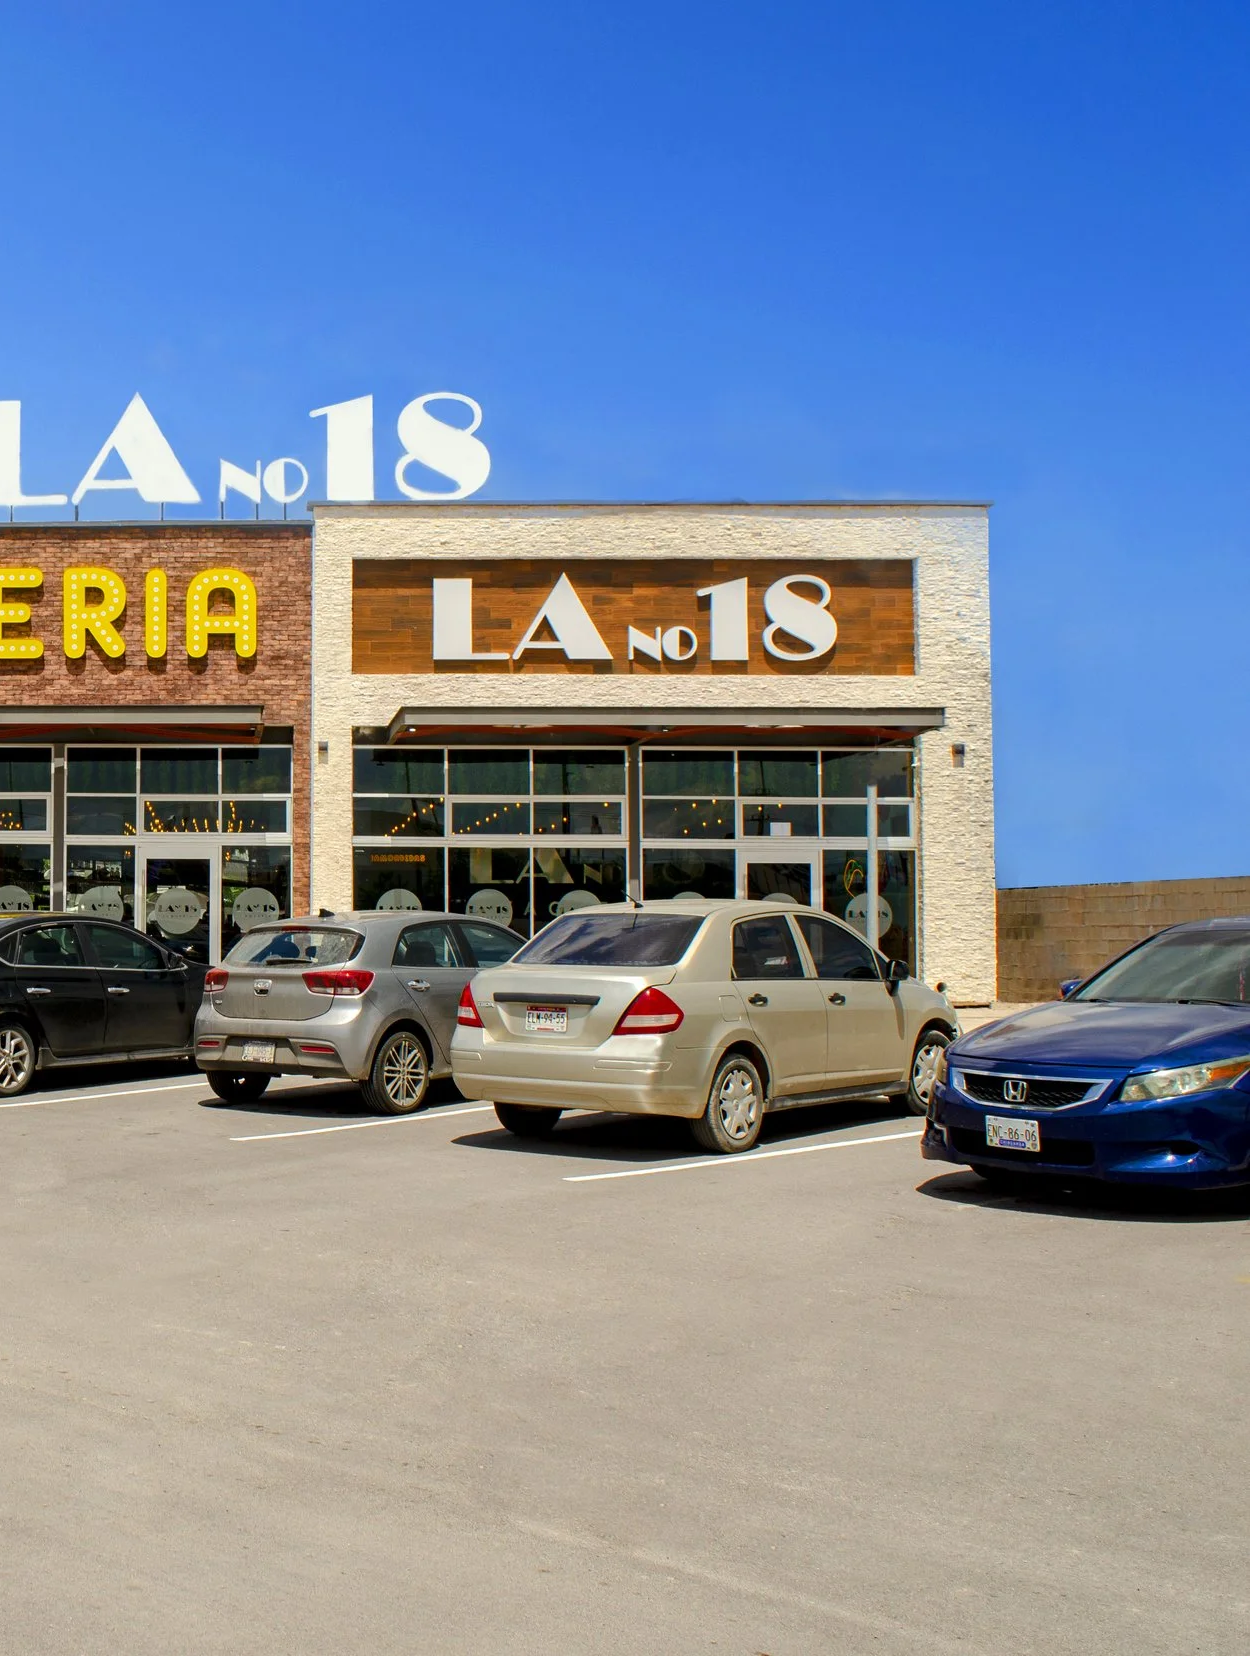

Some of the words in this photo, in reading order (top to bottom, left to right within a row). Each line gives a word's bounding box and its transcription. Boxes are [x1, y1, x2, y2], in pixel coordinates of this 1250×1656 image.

[309, 393, 492, 503] 18
[432, 572, 614, 661] LA
[697, 574, 838, 661] 18
[987, 1124, 1037, 1142] ENC-86-06
